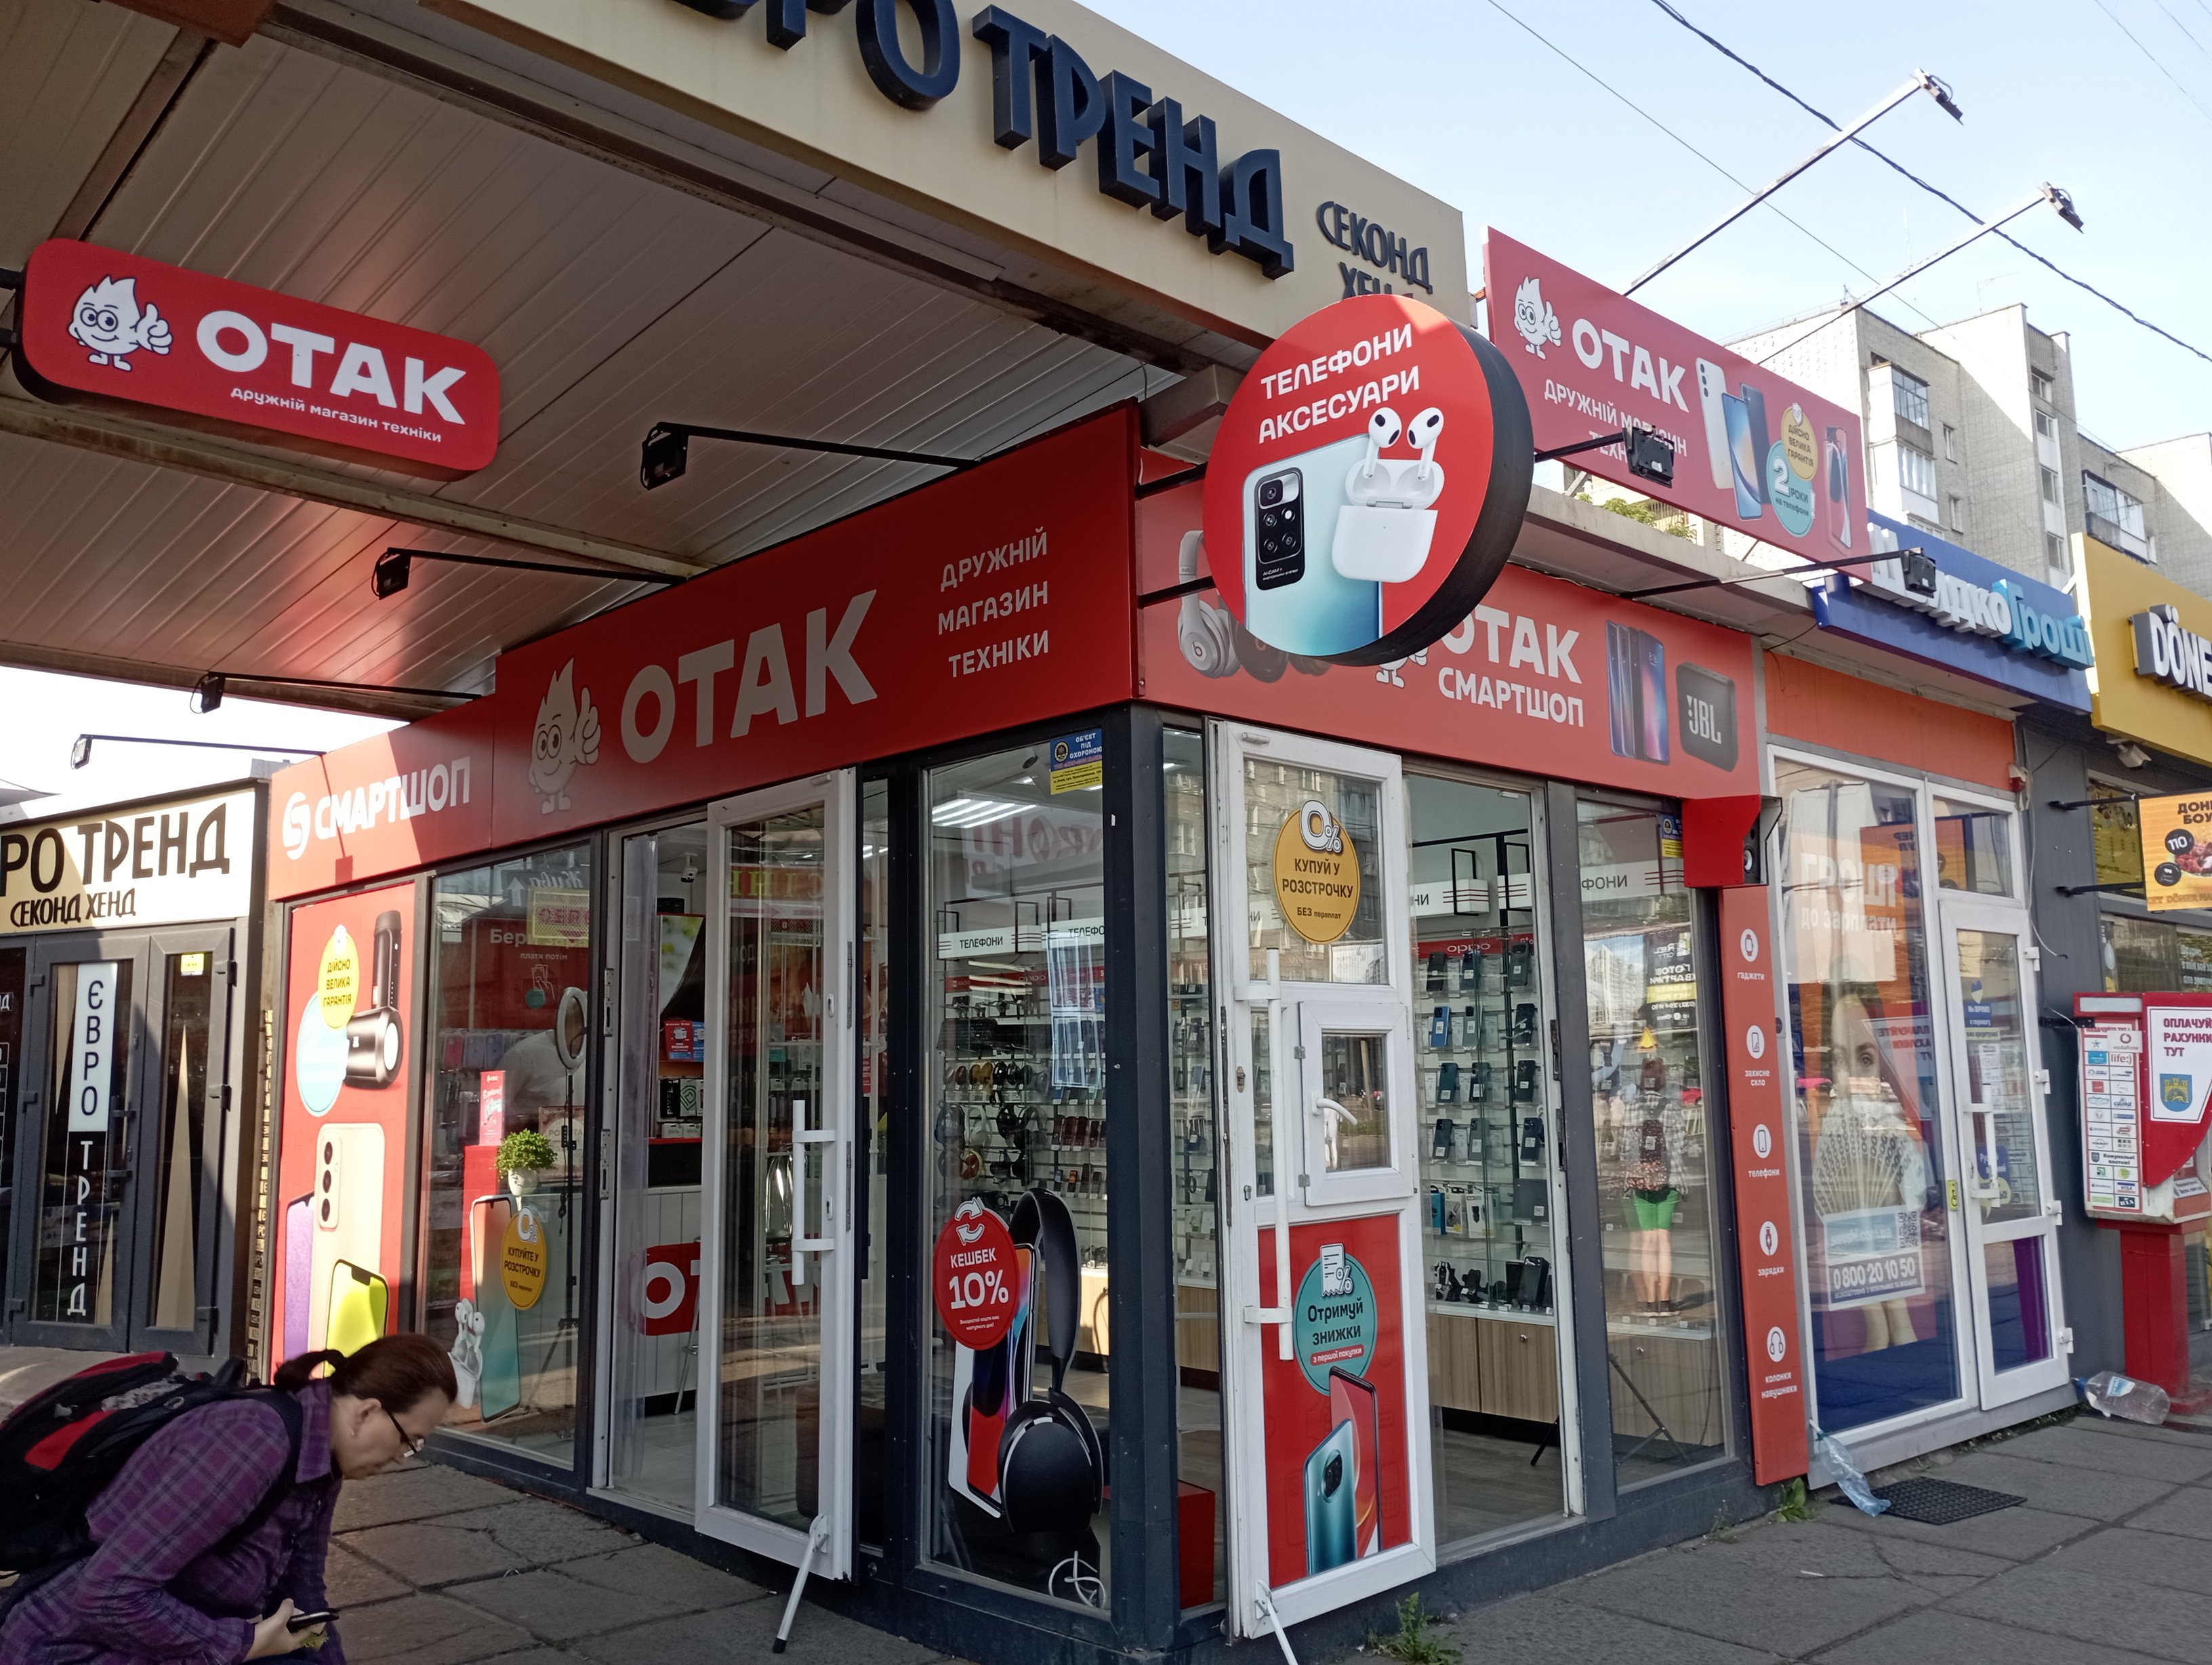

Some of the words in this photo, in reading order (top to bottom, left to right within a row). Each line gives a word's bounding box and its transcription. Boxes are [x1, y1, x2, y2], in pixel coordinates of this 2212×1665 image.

[972, 3, 1294, 280] ТРЕНД
[1316, 201, 1433, 295] СЕКОНД
[1339, 262, 1414, 299] ХЕН
[197, 310, 467, 425] ОТАК
[1261, 323, 1412, 399] ТЕЛЕФОНИ
[1572, 318, 1689, 413] ОТАК
[1258, 365, 1420, 444] АКСЕСУАРИ
[1544, 379, 1617, 426] ДРУЖНІЙ
[310, 405, 377, 428] магазин
[382, 420, 442, 443] техніки
[1788, 425, 1809, 440] ДІЙСНО
[1788, 449, 1814, 467] ГАРАНТІЯ
[1789, 437, 1811, 453] ВЕЛИКА
[1774, 457, 1790, 497] 2
[1790, 487, 1809, 503] РОКИ
[941, 527, 1047, 592] ДРУЖНІЙ
[939, 581, 1048, 635] МАГАЗИН
[949, 630, 1048, 678] ТЕХНІКИ
[1441, 607, 1584, 684] ОТАК
[621, 590, 878, 763] ОТАК
[1439, 667, 1584, 728] СМАРТШОП
[1687, 695, 1722, 745] JBL
[1069, 746, 1102, 759] ОХОРОНОЮ
[1080, 741, 1092, 749] ПІД
[314, 756, 471, 841] СМАРТШОП
[1300, 800, 1342, 853] 0%
[78, 803, 230, 885] ТРЕНД
[2168, 836, 2188, 850] 110
[1294, 858, 1331, 875] КУПУЙ
[1334, 863, 1340, 876] У
[1282, 878, 1354, 898] РОЗСТРОЧКУ
[10, 894, 81, 927] СЕКОНД
[86, 888, 136, 918] ХЕНД
[1297, 907, 1312, 917] БЕЗ
[960, 937, 1003, 949] ТЕЛЕФОНИ
[327, 958, 350, 973] ДІЙСНО
[1737, 971, 1765, 981] гаджети
[326, 979, 350, 991] ВЕЛИКА
[323, 994, 352, 1008] ГАРАНТІЯ
[81, 981, 104, 1117] ЄВРО
[2163, 1046, 2185, 1057] ТУТ
[1748, 1168, 1780, 1179] телефони
[67, 1140, 93, 1316] ТРЕНД
[504, 1260, 541, 1278] РОЗСТРОЧКУ
[508, 1246, 534, 1262] КУПУЙТЕ
[950, 1247, 997, 1269] КЕШБЕК
[1757, 1267, 1784, 1277] зарядки
[1833, 1268, 1841, 1290] 0
[1842, 1265, 1866, 1288] 800
[1866, 1262, 1884, 1284] 20
[1884, 1259, 1899, 1280] 10
[1899, 1256, 1916, 1278] 50
[949, 1269, 1009, 1309] 10%
[1308, 1297, 1364, 1324] Отримуй
[1312, 1325, 1361, 1346] знижки
[1317, 1350, 1338, 1362] першої
[1338, 1348, 1362, 1357] покупки
[1761, 1385, 1797, 1399] навушники
[1765, 1372, 1792, 1384] колонки
